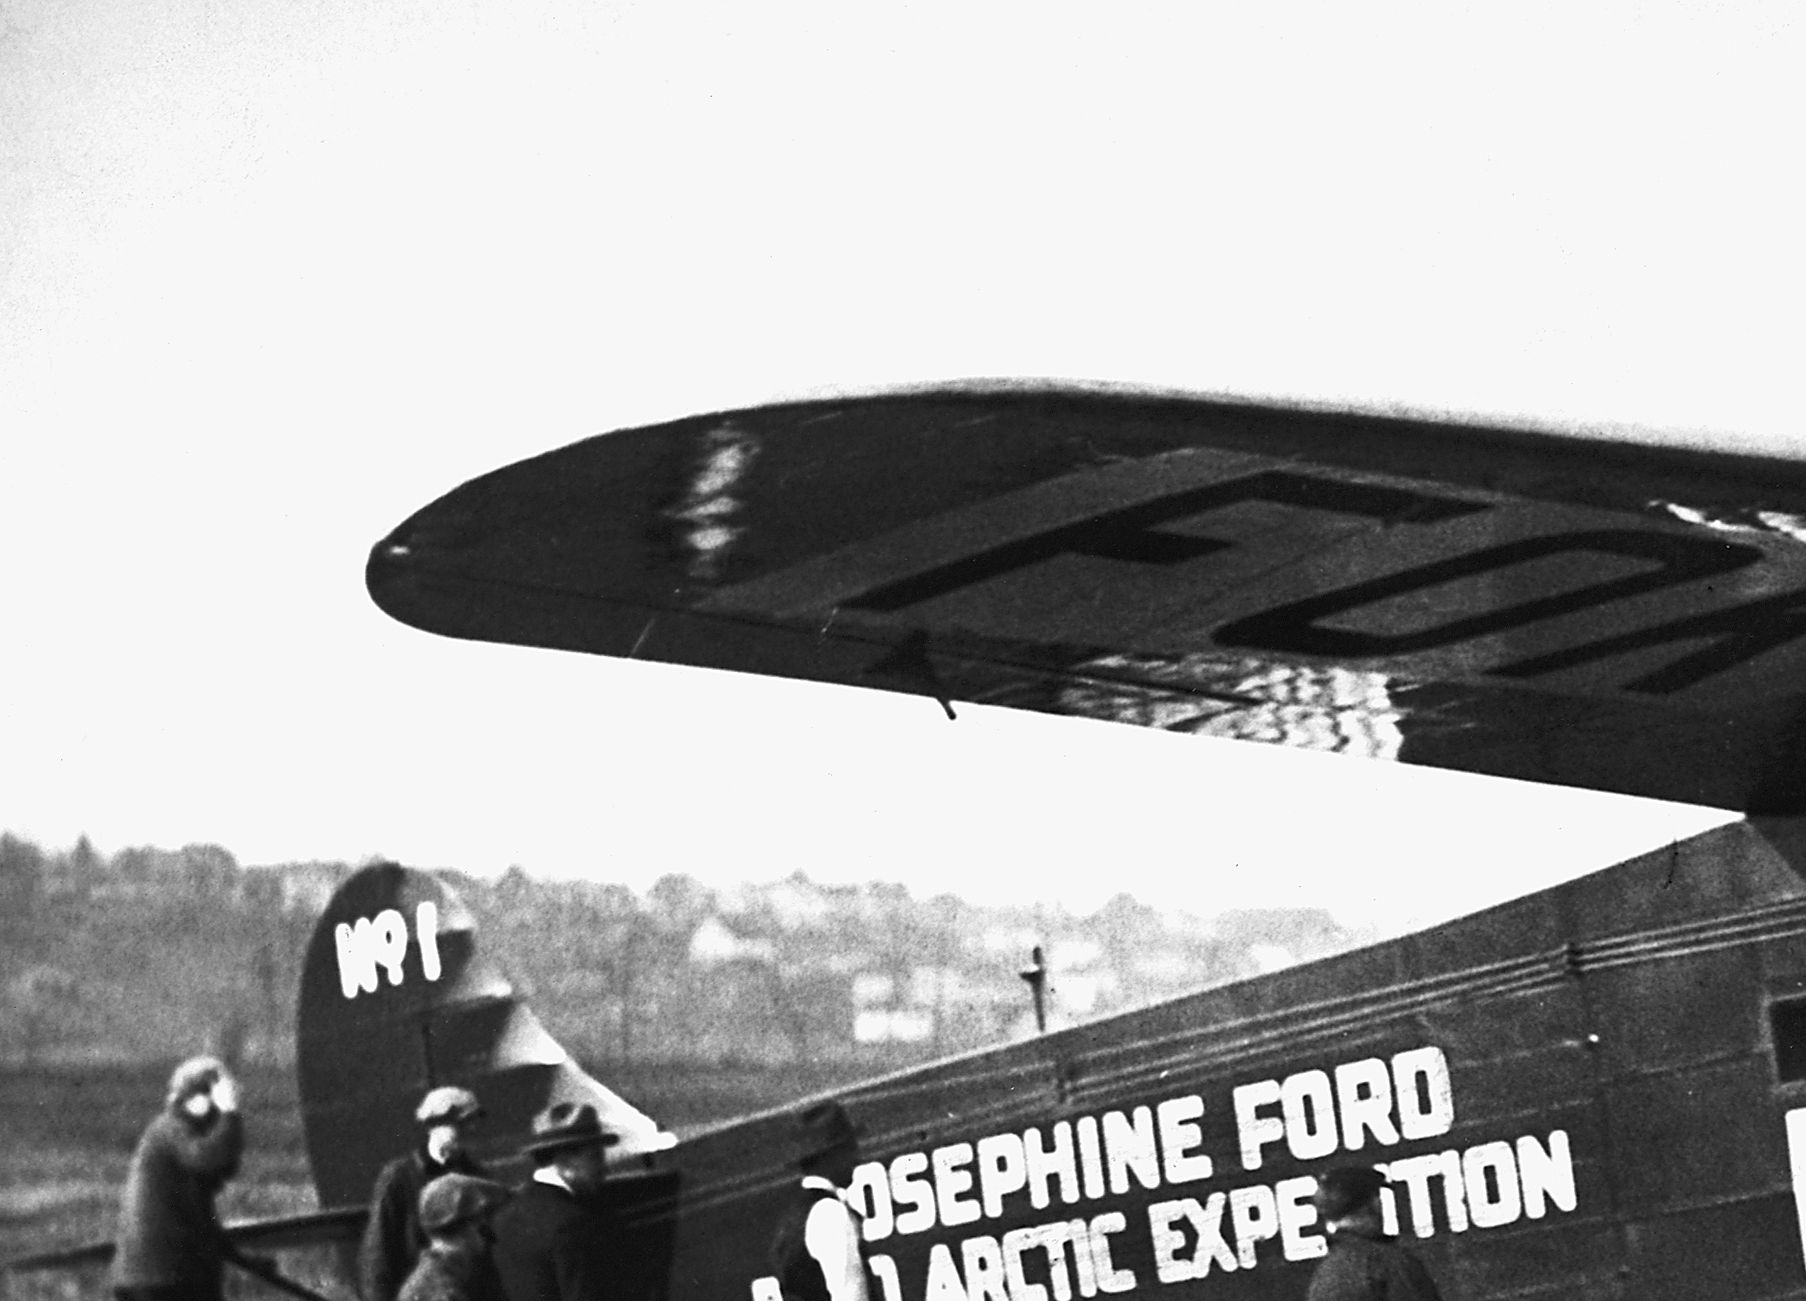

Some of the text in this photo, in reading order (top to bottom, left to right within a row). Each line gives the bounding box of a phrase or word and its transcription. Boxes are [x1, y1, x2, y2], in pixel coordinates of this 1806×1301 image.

[847, 1046, 1454, 1242] OSEPHINE FORD
[1148, 1130, 1577, 1283] EXPEITION
